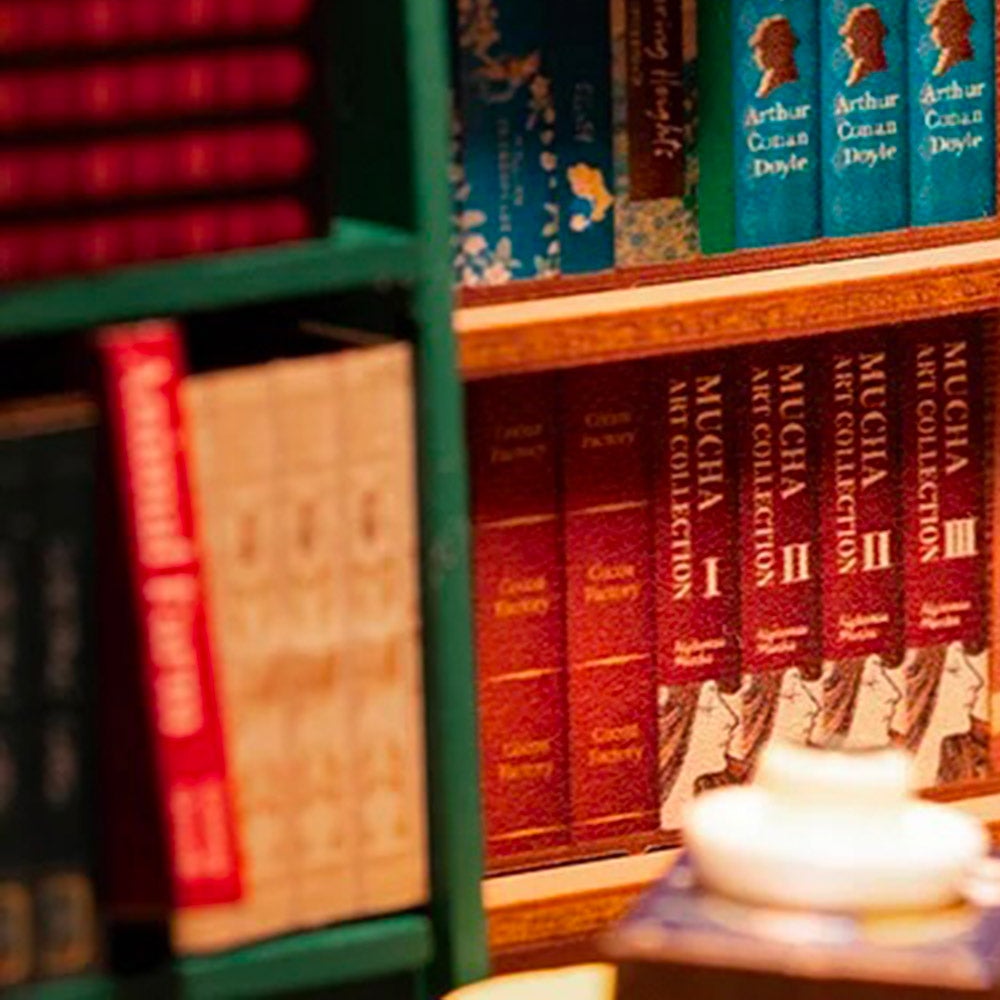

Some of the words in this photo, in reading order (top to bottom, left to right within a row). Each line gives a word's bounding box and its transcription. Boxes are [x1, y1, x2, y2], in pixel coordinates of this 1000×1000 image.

[744, 101, 811, 127] Arthur
[834, 91, 899, 116] Arthur
[920, 81, 985, 105] Arthur
[747, 130, 809, 152] Conan
[837, 118, 897, 141] Conan
[925, 108, 983, 129] Conan
[753, 154, 808, 180] Doyle
[844, 143, 898, 168] Doyle
[929, 132, 983, 158] Doyle
[833, 355, 852, 402] ART
[916, 344, 935, 392] ART
[670, 378, 689, 428] ART
[751, 367, 769, 416] ART
[943, 341, 969, 475] MUCHA
[695, 373, 724, 512] MUCHA
[779, 364, 807, 500] MUCHA
[858, 351, 889, 490] MUCHA
[834, 407, 857, 575] COLLECTION
[916, 398, 941, 564] COLLECTION
[670, 434, 692, 600] COLLECTION
[752, 420, 776, 588] COLLECTION
[780, 542, 811, 584] II
[862, 529, 891, 572] II
[703, 556, 722, 599] I
